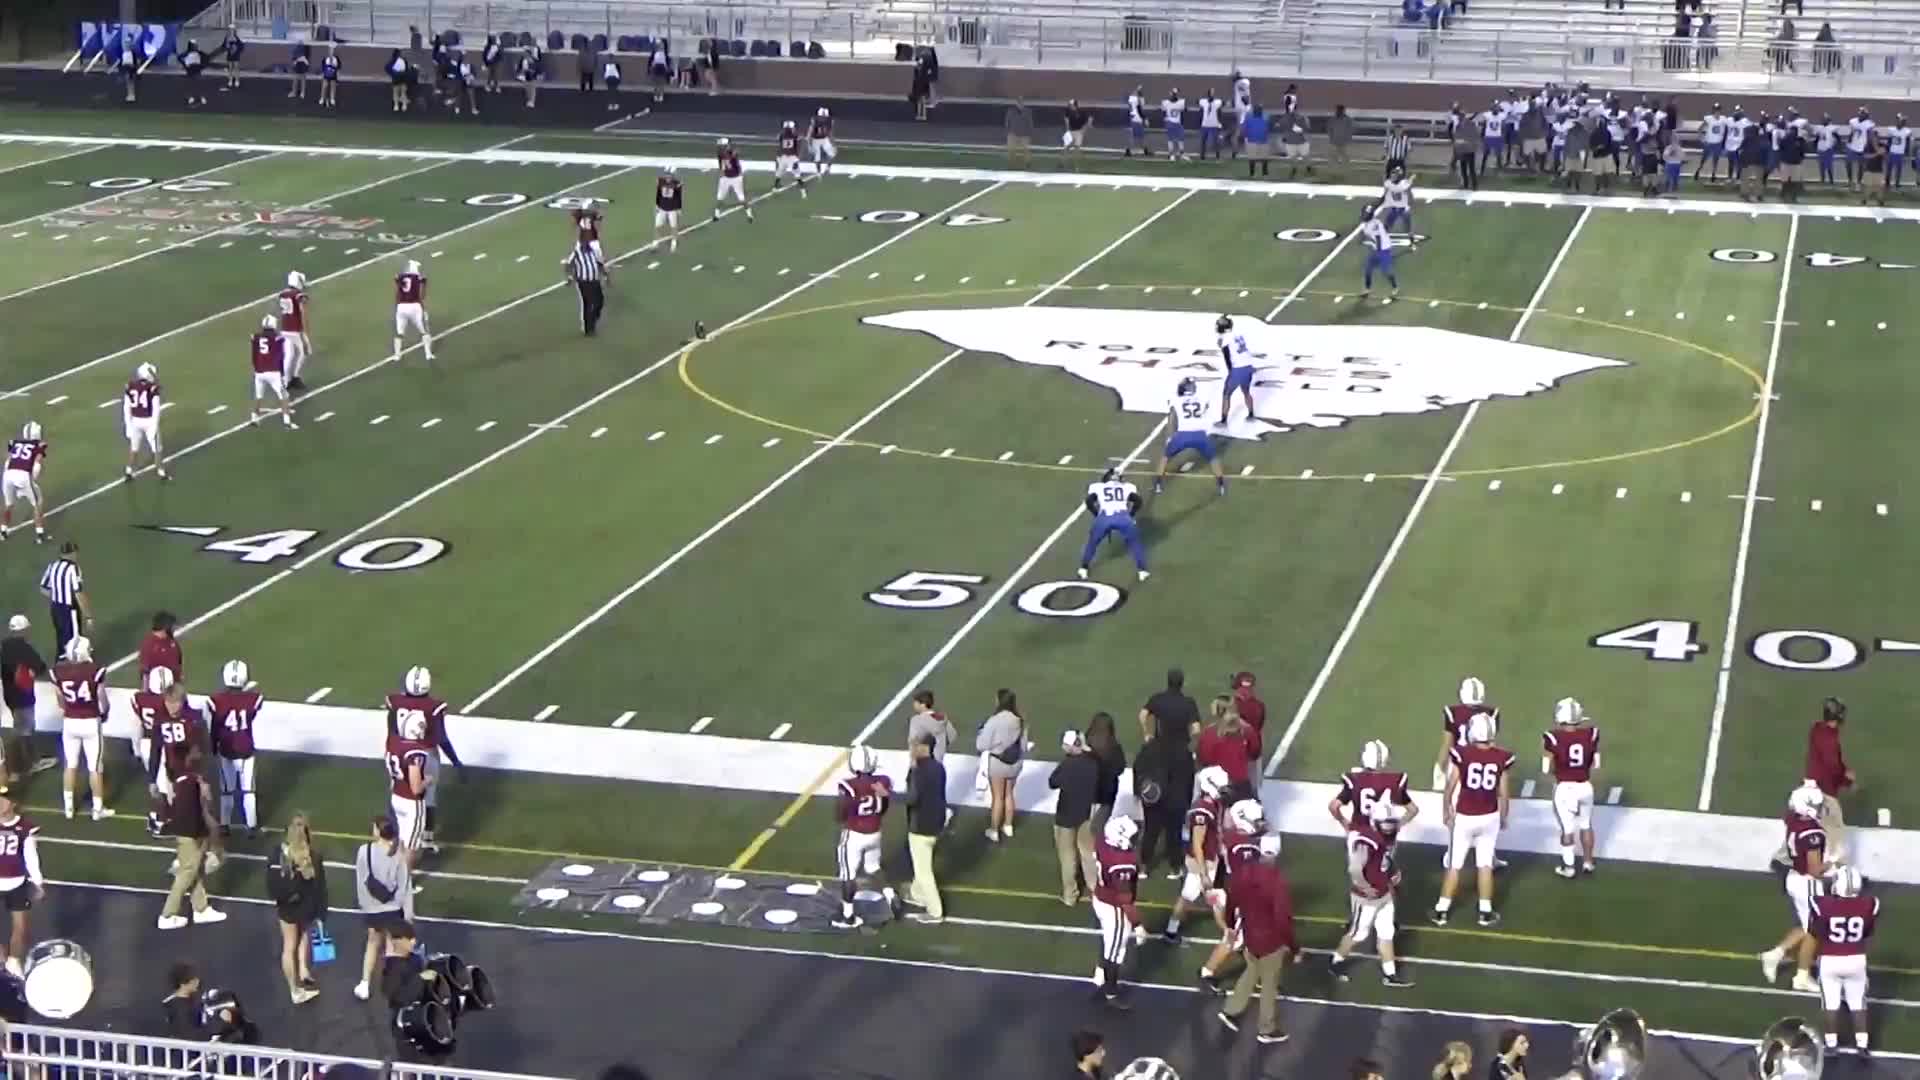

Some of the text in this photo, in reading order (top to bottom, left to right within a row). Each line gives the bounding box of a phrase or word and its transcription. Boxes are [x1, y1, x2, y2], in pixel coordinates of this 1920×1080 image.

[258, 338, 270, 355] 5
[129, 390, 149, 408] 34
[1181, 402, 1201, 419] 52
[10, 443, 33, 461] 35
[1103, 486, 1126, 503] 50
[60, 680, 92, 703] 54
[159, 719, 186, 743] 58
[223, 708, 249, 732] 41
[1568, 742, 1585, 768] 9
[1466, 762, 1499, 792] 66
[1829, 916, 1865, 943] 59
